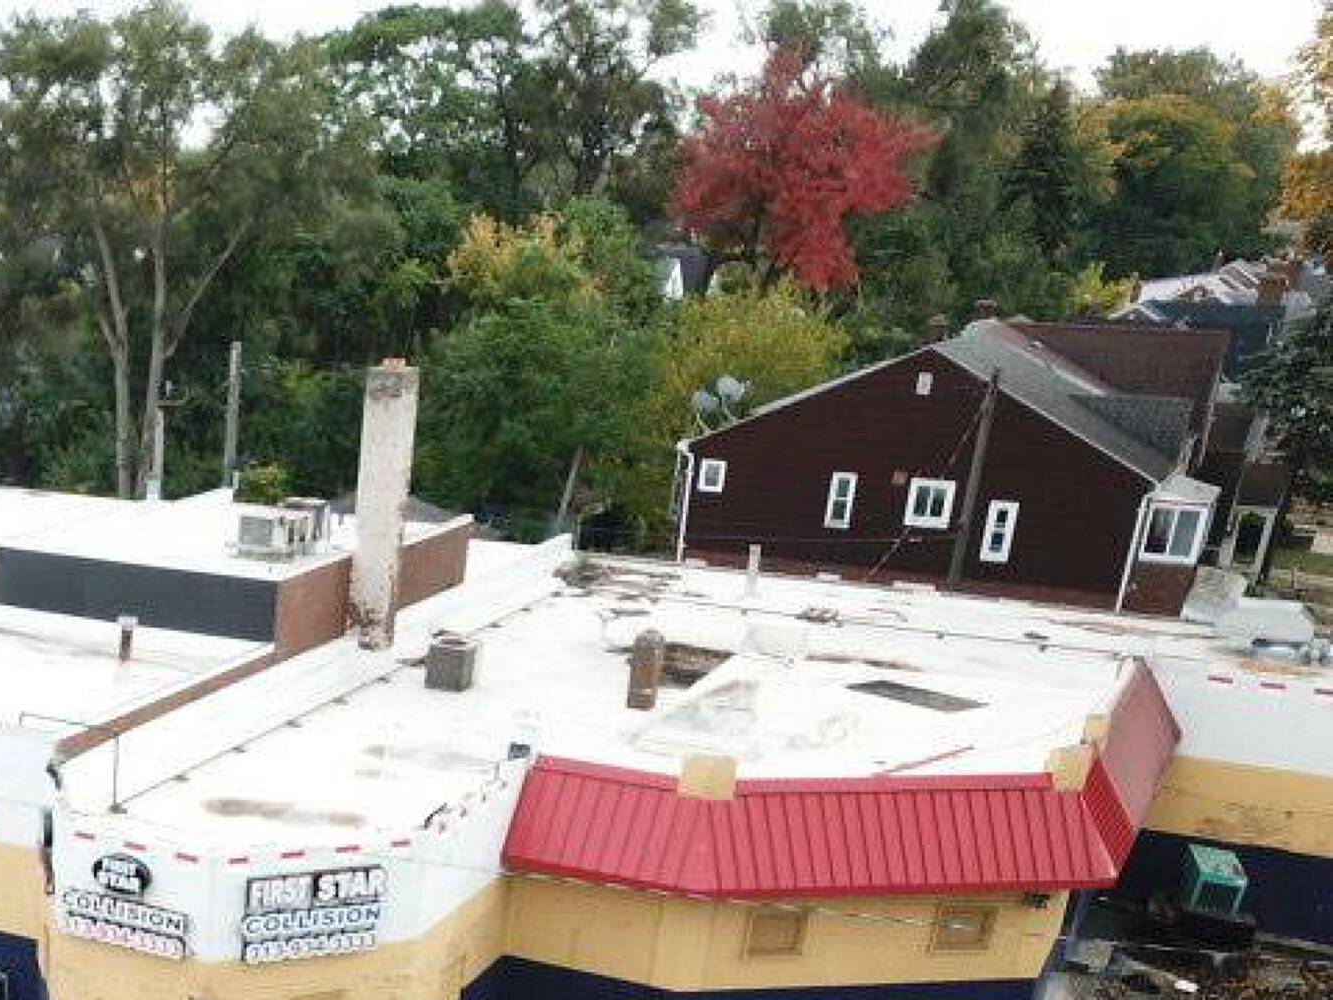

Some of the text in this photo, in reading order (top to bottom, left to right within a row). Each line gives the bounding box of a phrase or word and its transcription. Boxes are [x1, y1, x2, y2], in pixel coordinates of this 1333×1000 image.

[249, 869, 384, 908] FIRST STAR
[62, 890, 186, 935] COLLISION
[244, 903, 381, 935] COLLISION
